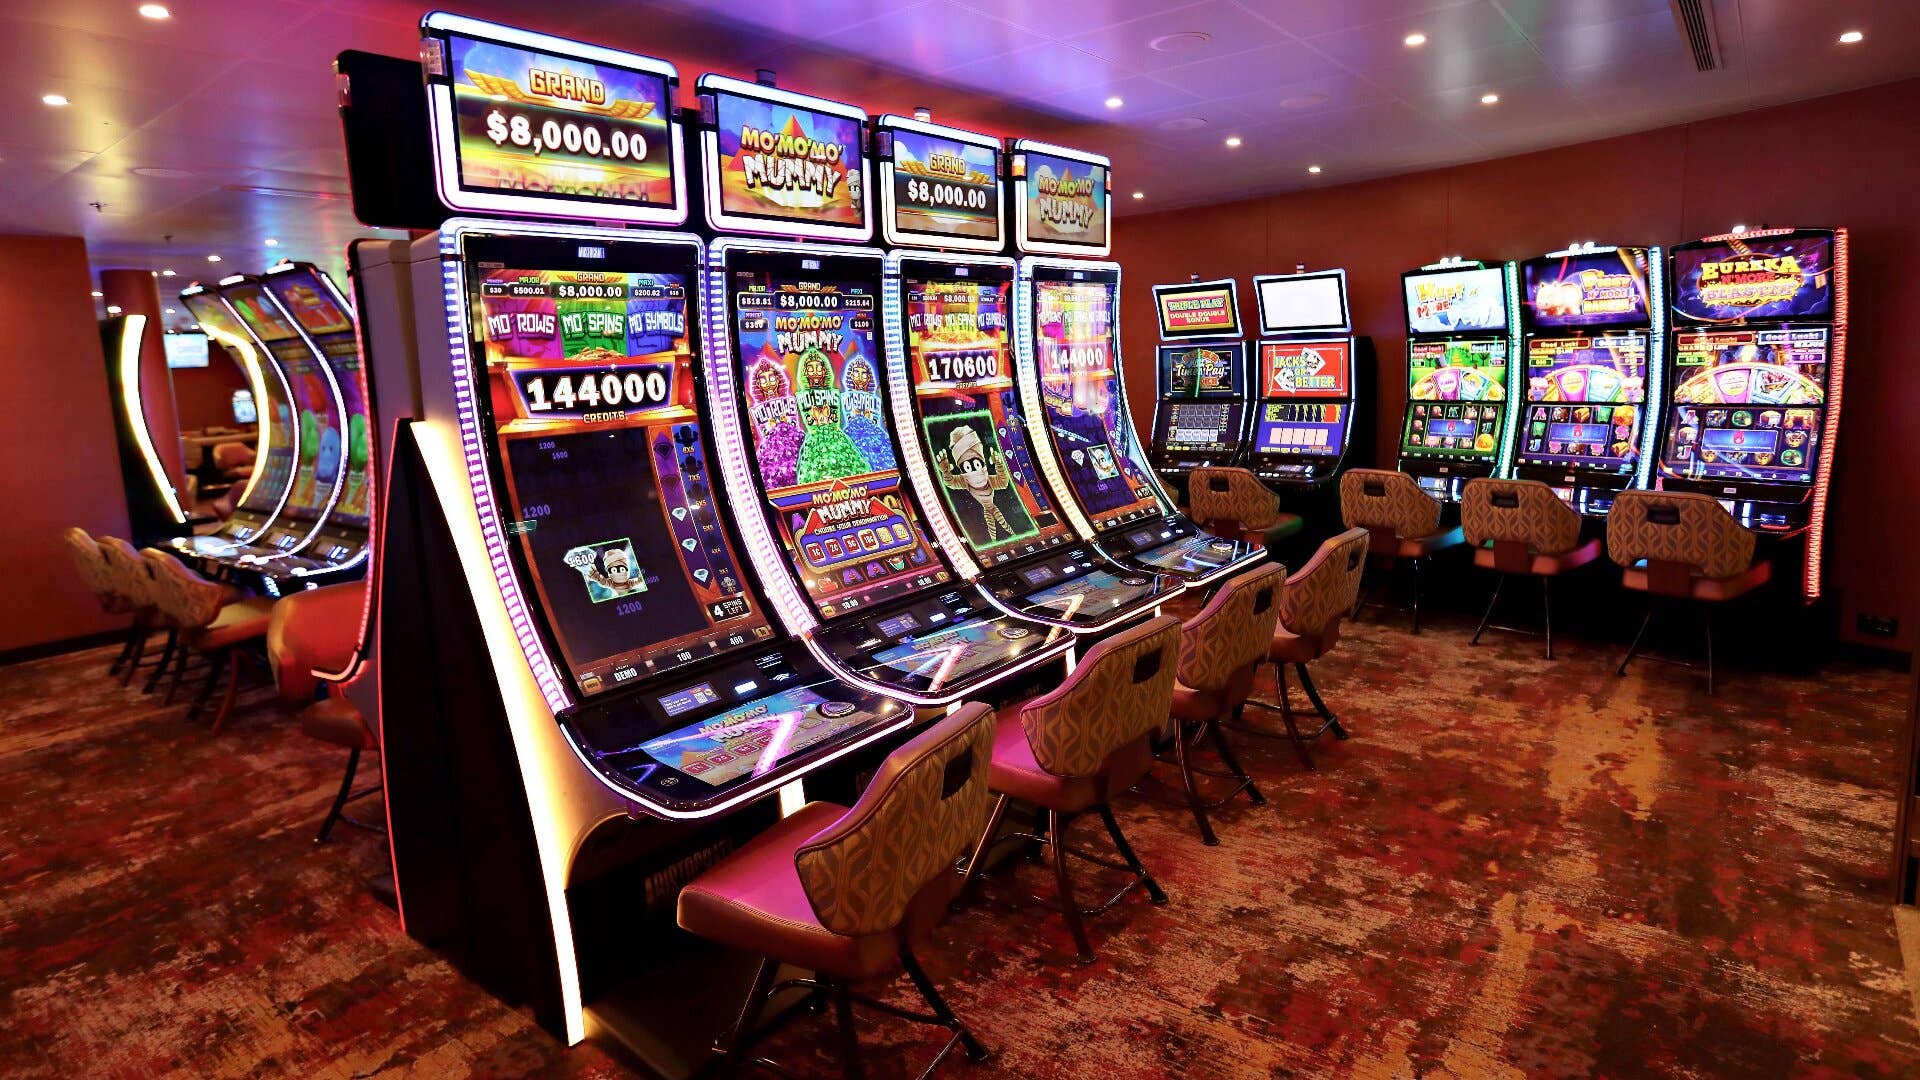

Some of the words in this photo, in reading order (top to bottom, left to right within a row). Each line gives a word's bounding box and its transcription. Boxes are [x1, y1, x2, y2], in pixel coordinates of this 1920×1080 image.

[529, 68, 605, 105] GRAND
[486, 110, 648, 161] $8,000.00
[929, 153, 966, 175] GRAND
[742, 153, 841, 199] MUMMY
[908, 178, 987, 210] $8,000.00
[1040, 198, 1094, 229] MUMMY
[576, 272, 606, 283] GRAND
[1701, 256, 1801, 281] EUREKA
[559, 284, 622, 299] $8,000.00
[798, 282, 821, 291] GRAND
[780, 294, 838, 310] $8,000.00
[516, 312, 557, 338] ROWS
[587, 311, 625, 338] SPINS
[645, 310, 685, 335] SYMBOLS
[776, 331, 844, 354] MUMMY
[928, 355, 997, 380] 170600
[1050, 347, 1103, 369] 144000
[1274, 356, 1307, 368] JACKS
[1205, 362, 1225, 378] Pay
[527, 371, 667, 412] 144000
[1295, 376, 1336, 389] BETTER
[539, 441, 555, 450] 1200
[523, 504, 551, 519] 1200
[817, 499, 872, 525] MUMMY
[616, 600, 643, 616] 1200
[714, 604, 724, 617] 4
[723, 598, 743, 609] SPINS
[727, 605, 744, 615] LEFT
[677, 650, 692, 662] 100
[614, 667, 638, 682] DEMO
